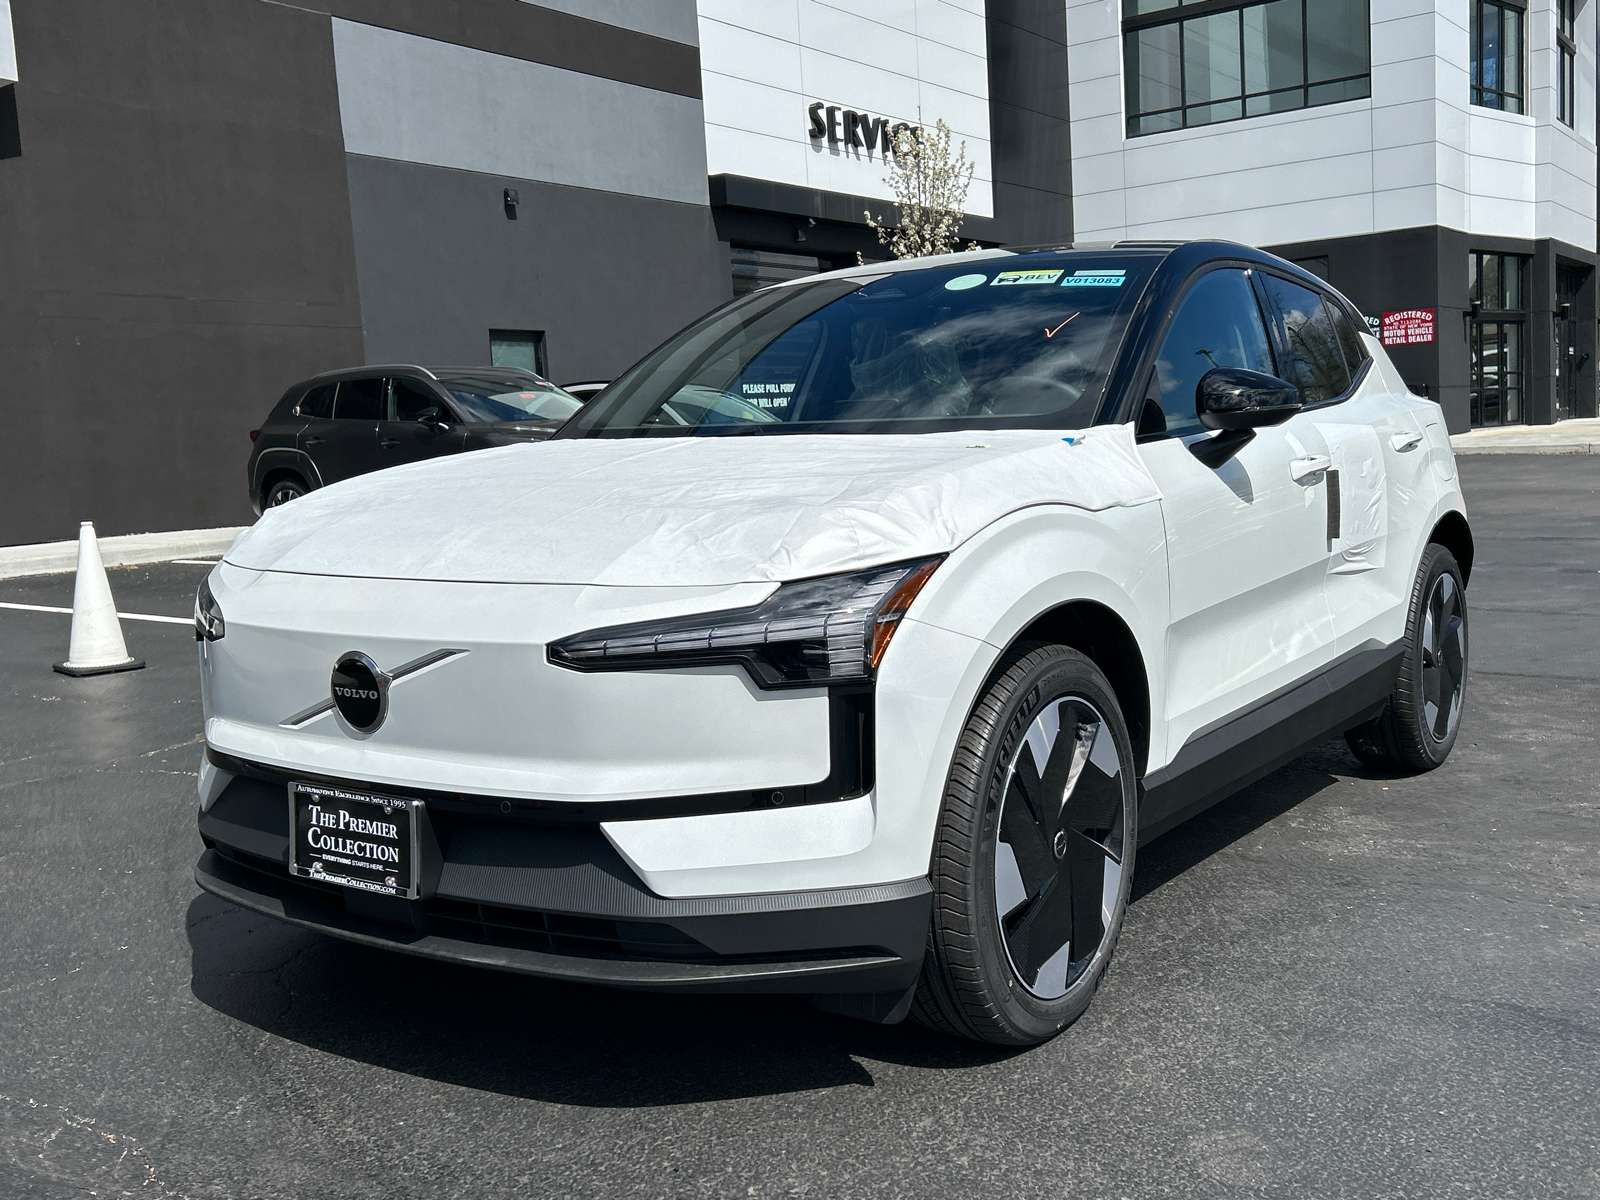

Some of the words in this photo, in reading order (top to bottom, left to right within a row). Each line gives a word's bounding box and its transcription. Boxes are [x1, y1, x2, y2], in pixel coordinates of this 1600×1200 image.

[1384, 311, 1432, 325] REGISTERED
[1384, 329, 1405, 337] MOTOR
[1407, 326, 1433, 335] VEHICLE
[1385, 337, 1406, 345] RETAIL
[1408, 334, 1432, 343] DEALER
[742, 383, 765, 393] PLEASE
[766, 383, 780, 393] PULL
[758, 398, 773, 407] WILL
[773, 397, 788, 407] OPEN
[335, 686, 378, 700] VOLVO
[989, 686, 1039, 804] MICHELIN
[390, 799, 406, 809] 1995
[308, 804, 337, 829] THE
[338, 809, 399, 840] PREMIER
[307, 826, 399, 863] COLLECTION
[322, 854, 351, 865] EVERYTHING
[351, 860, 370, 869] STARTS
